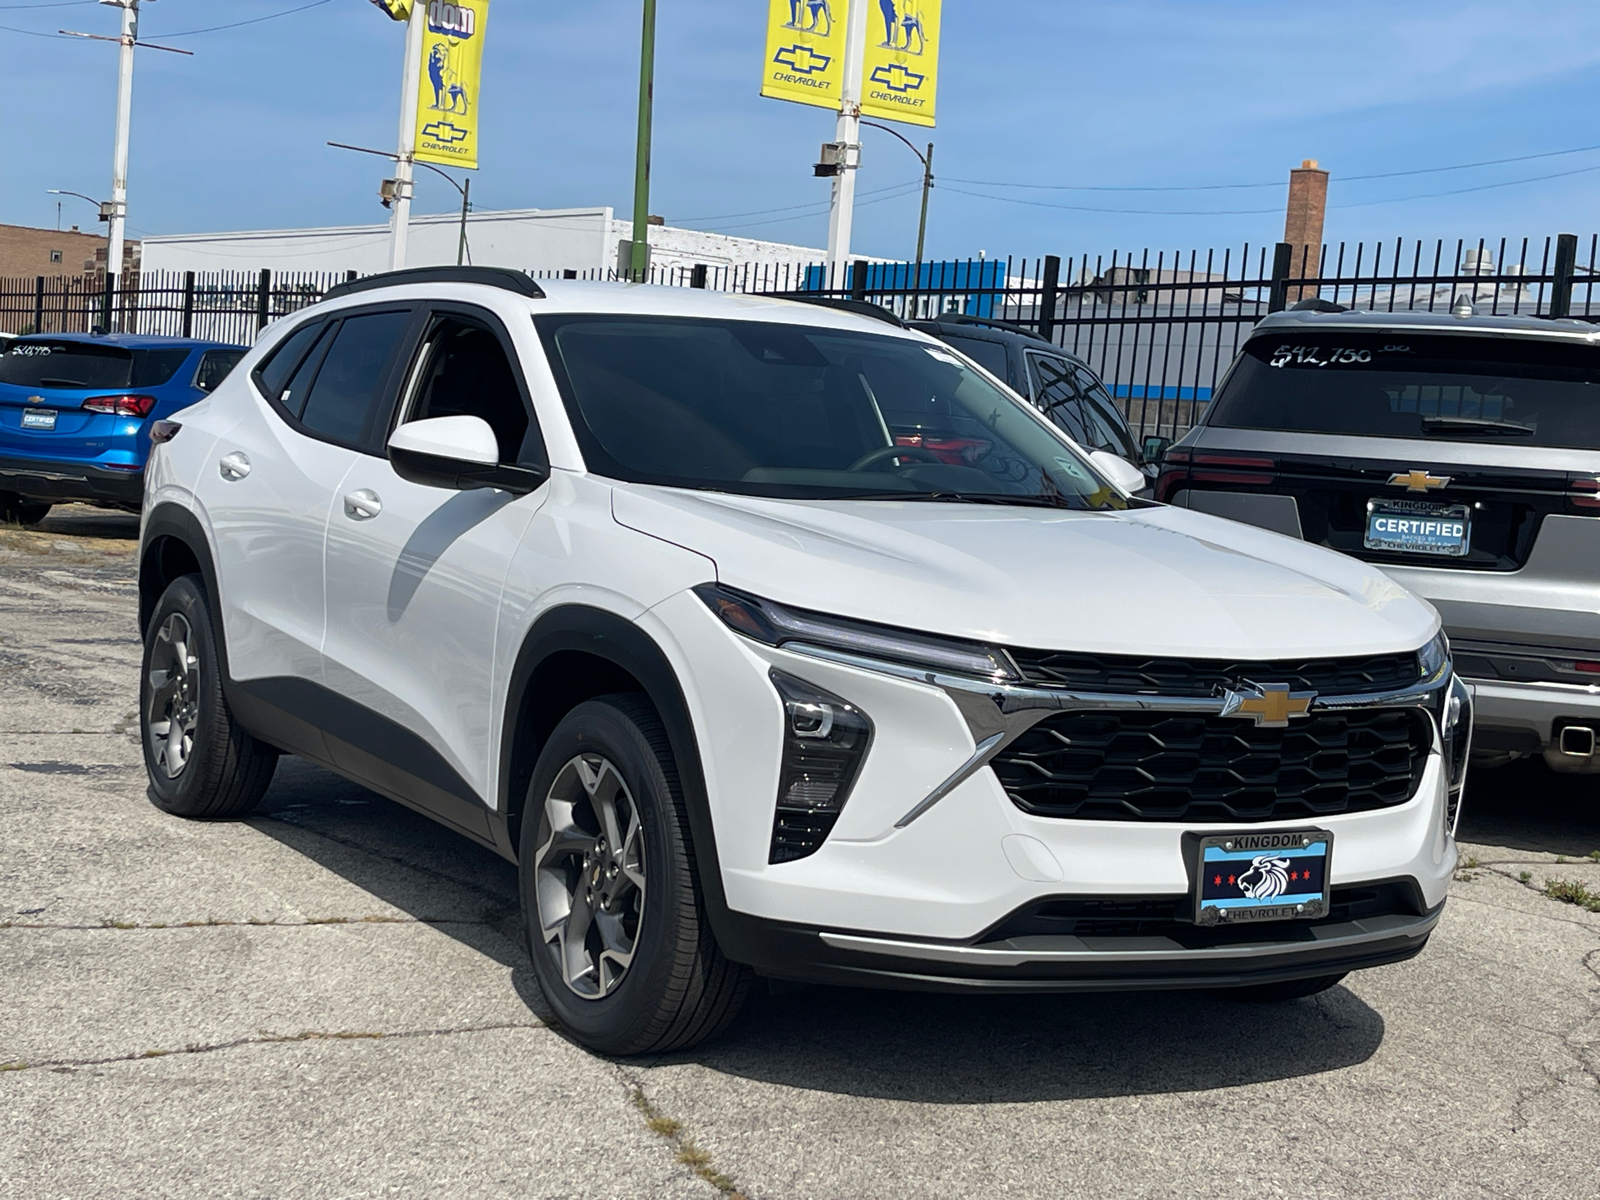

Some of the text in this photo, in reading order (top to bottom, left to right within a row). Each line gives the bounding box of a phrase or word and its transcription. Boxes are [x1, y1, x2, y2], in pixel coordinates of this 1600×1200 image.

[429, 0, 475, 35] dom
[773, 72, 831, 90] CHEVROLET
[870, 90, 926, 107] CHEVROLET
[421, 142, 469, 154] CHEVROLET
[1270, 344, 1371, 367] $42,750
[1392, 501, 1448, 512] KINGDOM
[1375, 518, 1464, 537] CERTIFIED
[1388, 542, 1442, 552] CHEVROLET
[1234, 834, 1303, 849] KINGDOM
[1226, 907, 1297, 920] CHEVROLET
